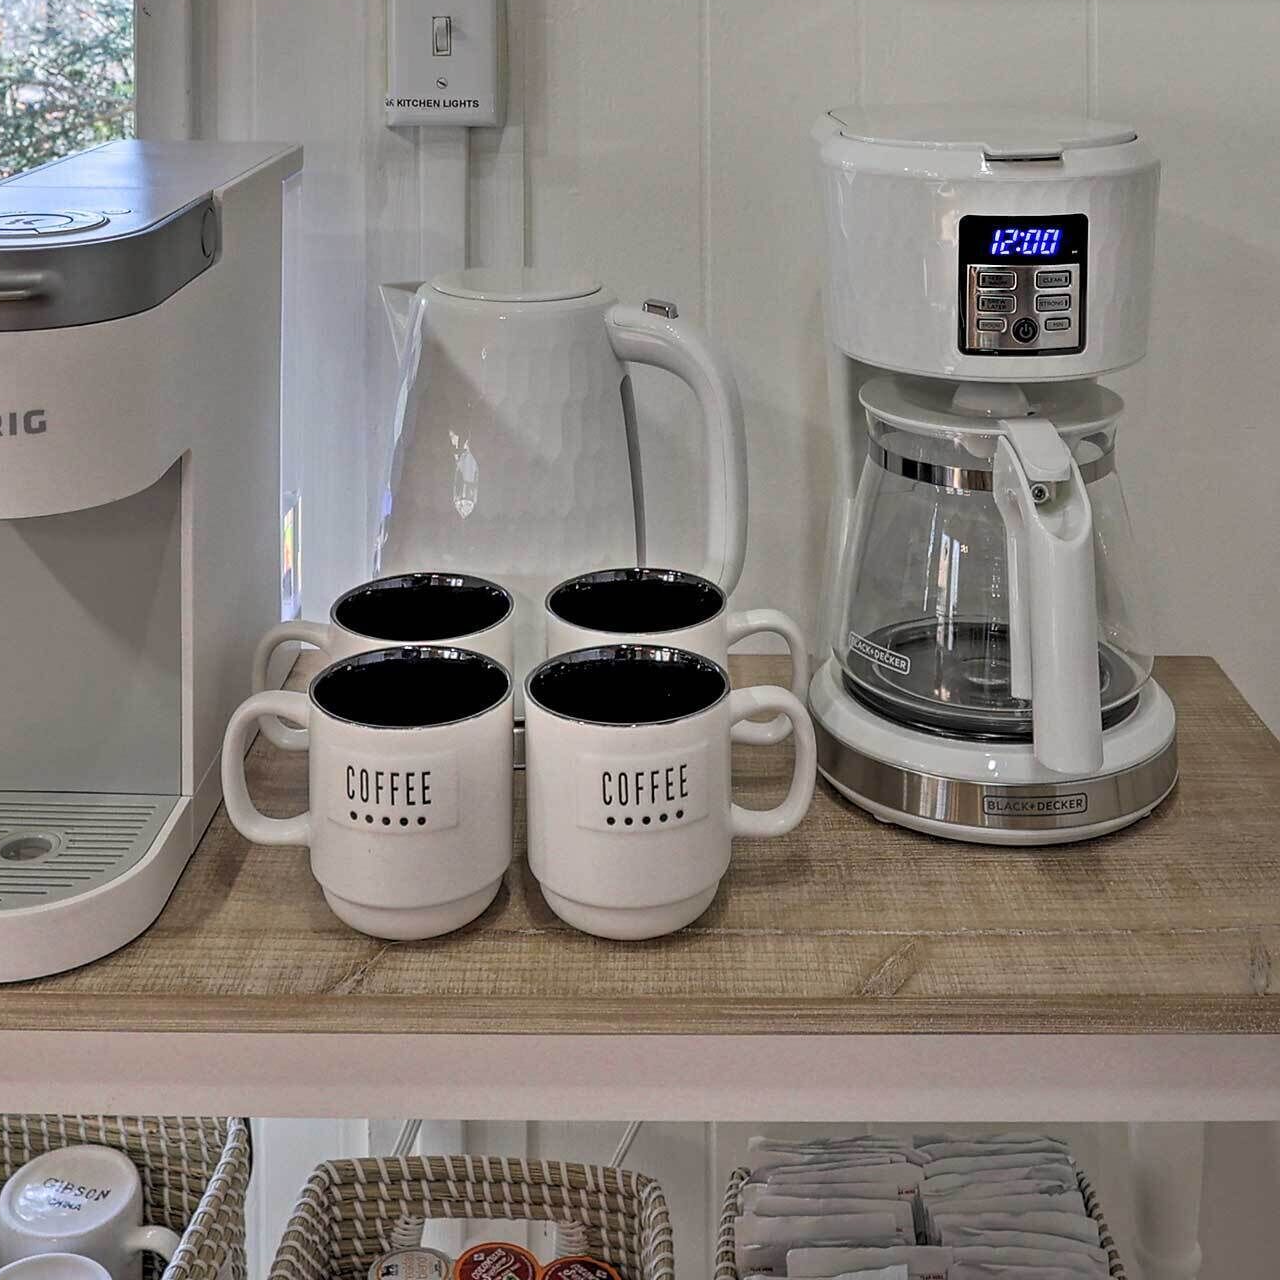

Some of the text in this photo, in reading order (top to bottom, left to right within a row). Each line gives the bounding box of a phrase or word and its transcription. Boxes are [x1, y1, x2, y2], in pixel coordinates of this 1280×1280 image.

[397, 99, 440, 108] KITCHEN
[443, 99, 480, 108] LIGHTS
[991, 229, 1060, 255] 12:00
[345, 764, 432, 806] COFFEE
[602, 764, 689, 806] COFFEE
[43, 1177, 111, 1201] GIBSON
